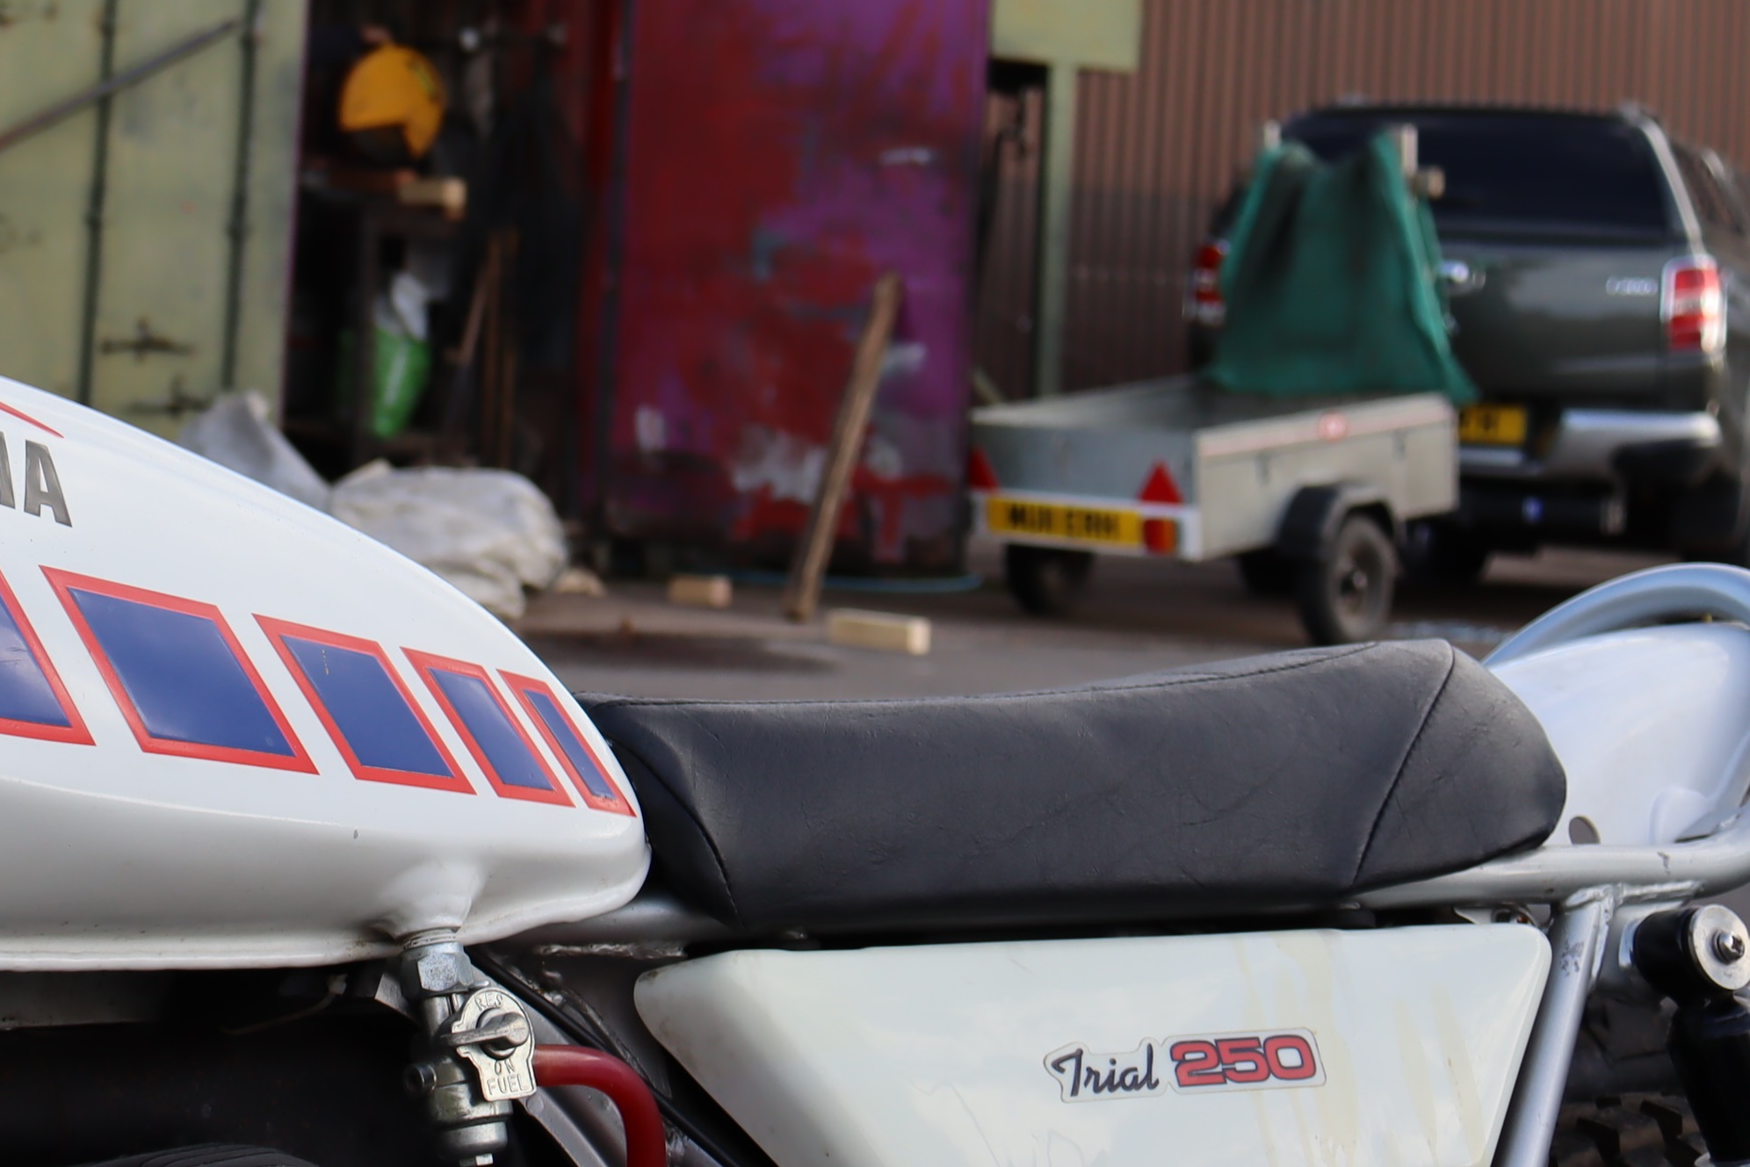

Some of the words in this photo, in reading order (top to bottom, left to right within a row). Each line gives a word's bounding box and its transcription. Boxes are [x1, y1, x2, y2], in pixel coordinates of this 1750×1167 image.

[474, 993, 503, 1011] RES
[494, 1057, 515, 1075] ON
[1051, 1042, 1159, 1097] Trial
[1170, 1034, 1317, 1088] 250
[487, 1074, 527, 1095] FUEL
